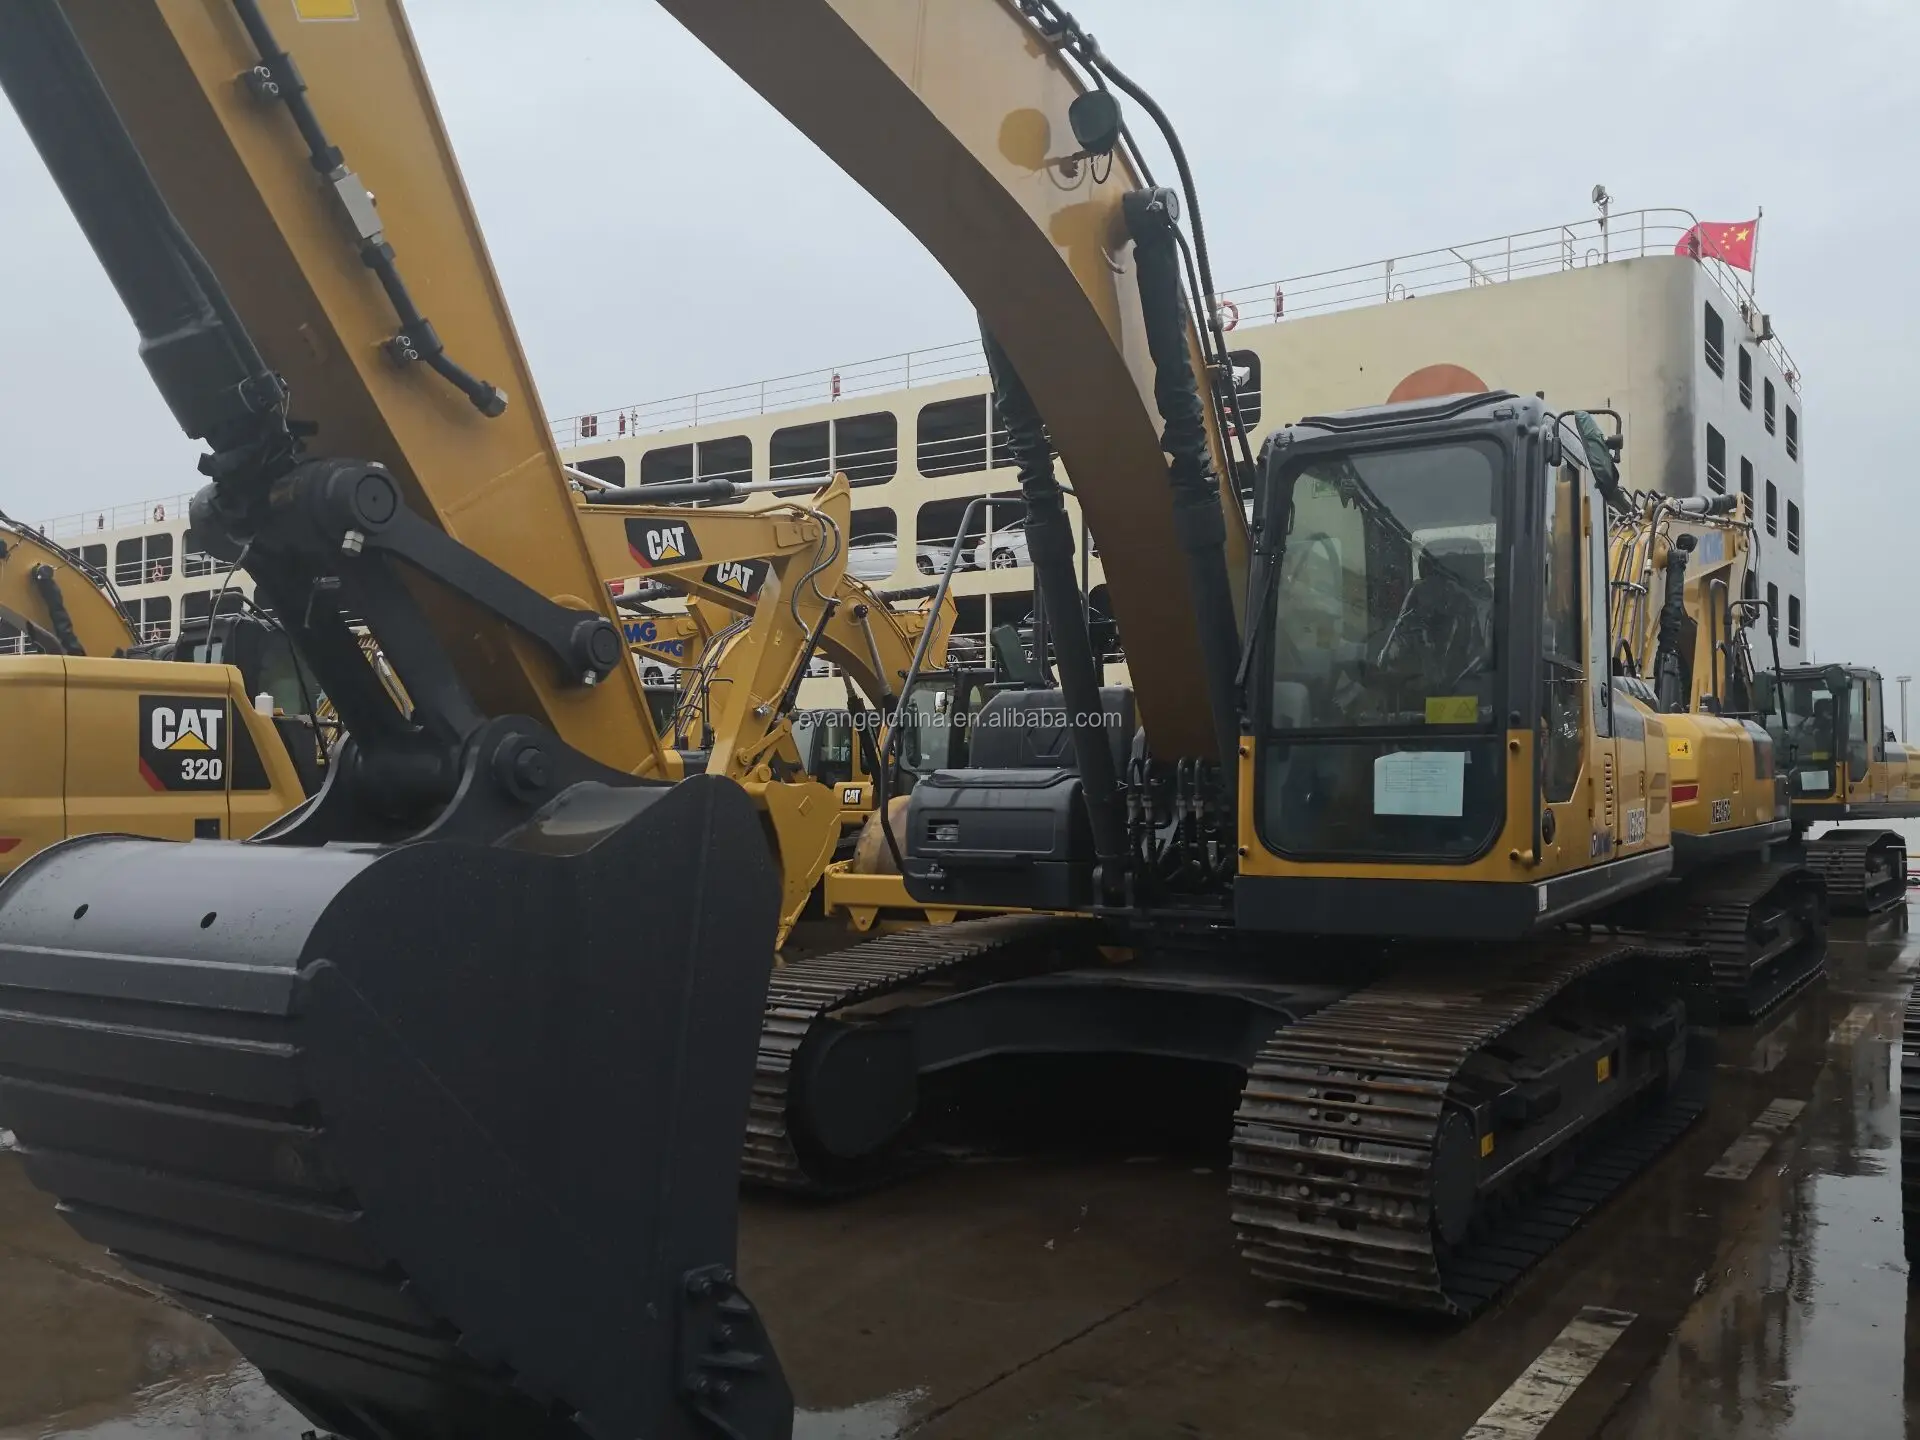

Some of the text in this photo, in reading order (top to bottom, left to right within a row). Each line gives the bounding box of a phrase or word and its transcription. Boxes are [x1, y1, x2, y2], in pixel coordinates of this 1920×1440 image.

[646, 527, 685, 560] CAT
[716, 562, 753, 592] CAT
[152, 707, 223, 750] CAT
[181, 758, 222, 780] 320
[845, 789, 860, 803] CAT
